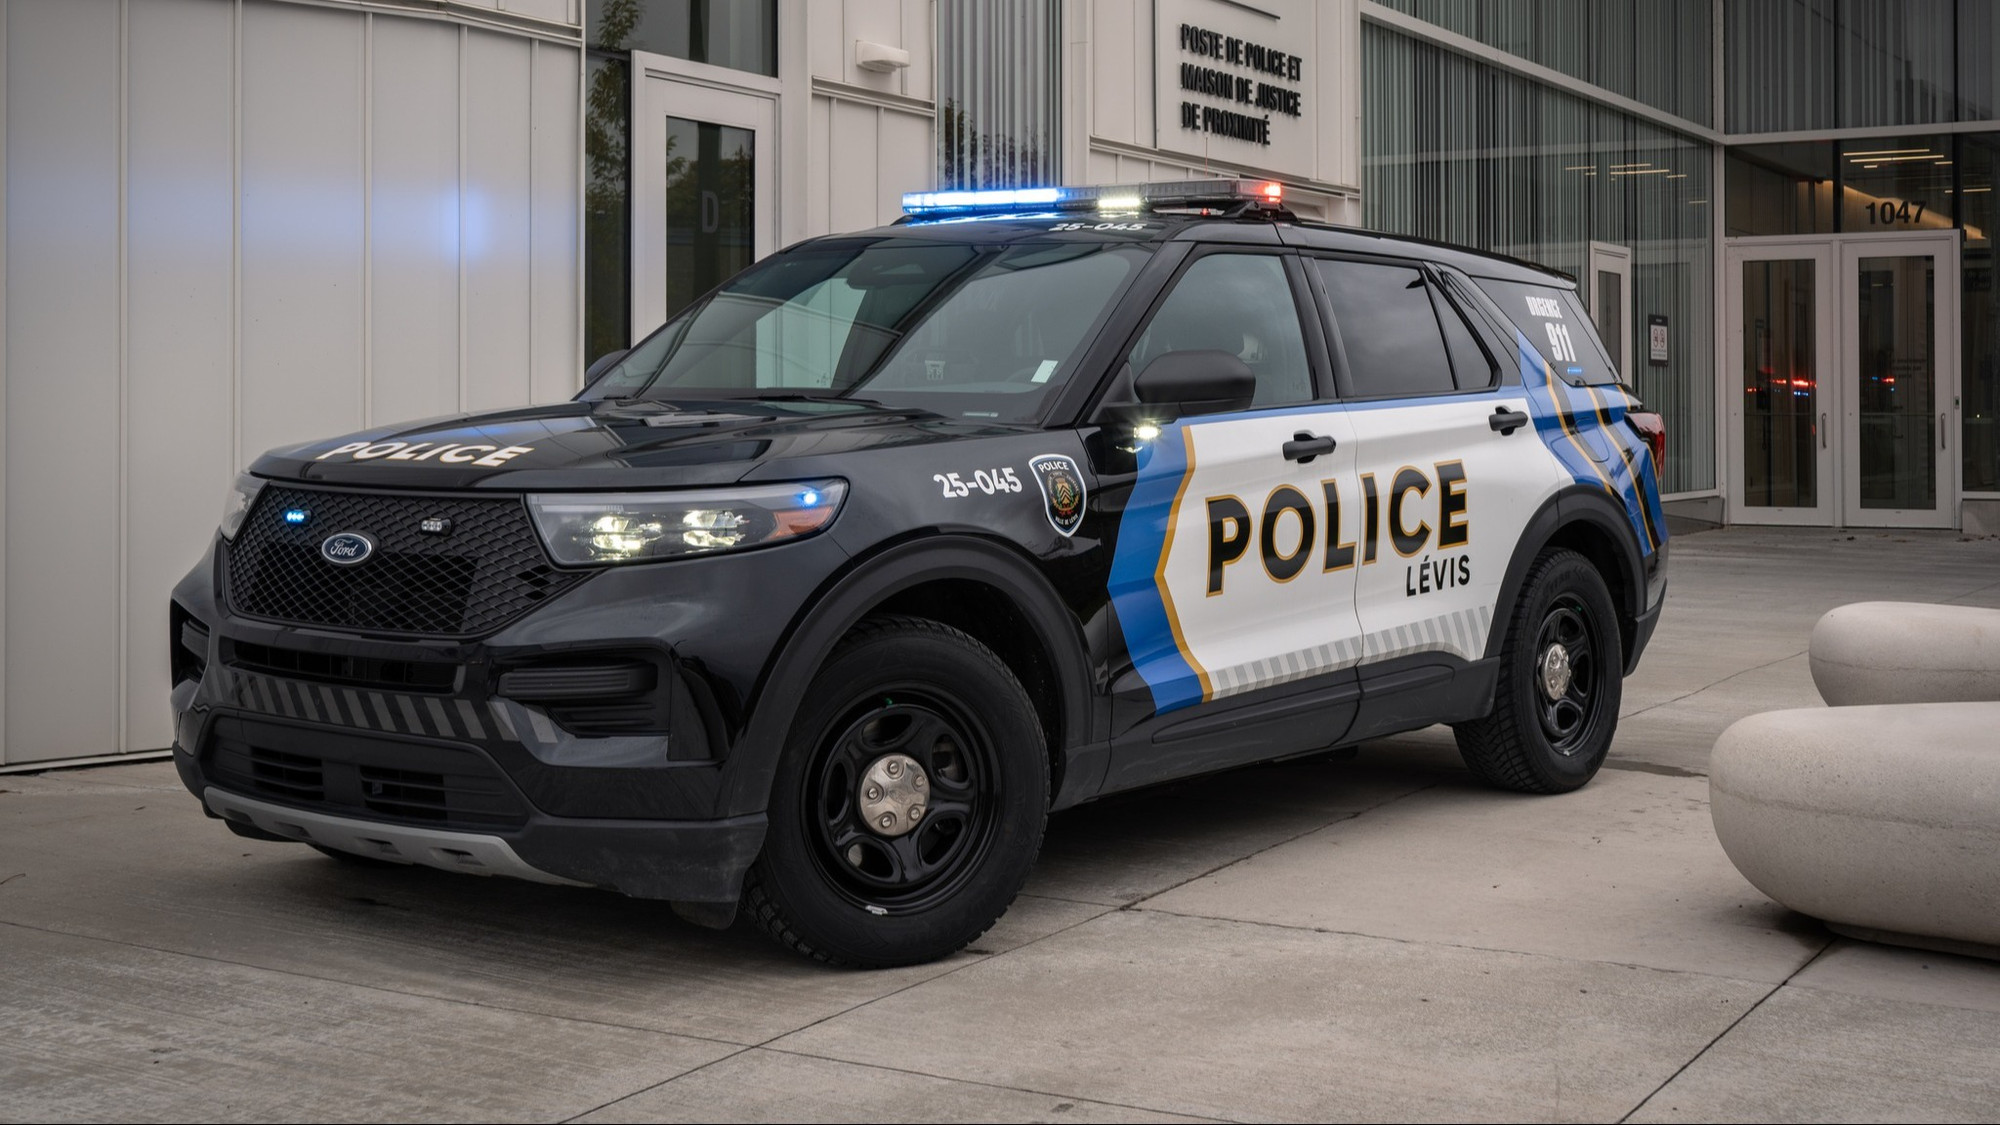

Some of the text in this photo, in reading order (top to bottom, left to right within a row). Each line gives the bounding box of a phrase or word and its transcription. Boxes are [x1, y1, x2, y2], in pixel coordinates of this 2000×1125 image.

[1180, 23, 1302, 82] POSTE DE POLICE ET
[1180, 62, 1301, 117] MAISON DE JUSTICE
[1180, 101, 1271, 146] DE PROXIMITÉ
[701, 190, 719, 233] D
[1048, 222, 1147, 232] 25-045
[1865, 200, 1927, 225] 1047
[1525, 295, 1563, 319] URGENCE
[1545, 322, 1576, 363] 911
[315, 441, 535, 468] POLICE
[1038, 461, 1070, 473] POLICE
[933, 466, 1022, 498] 25-045
[1205, 459, 1469, 598] POLICE
[330, 538, 358, 558] Ford
[1406, 555, 1471, 597] LÉVIS
